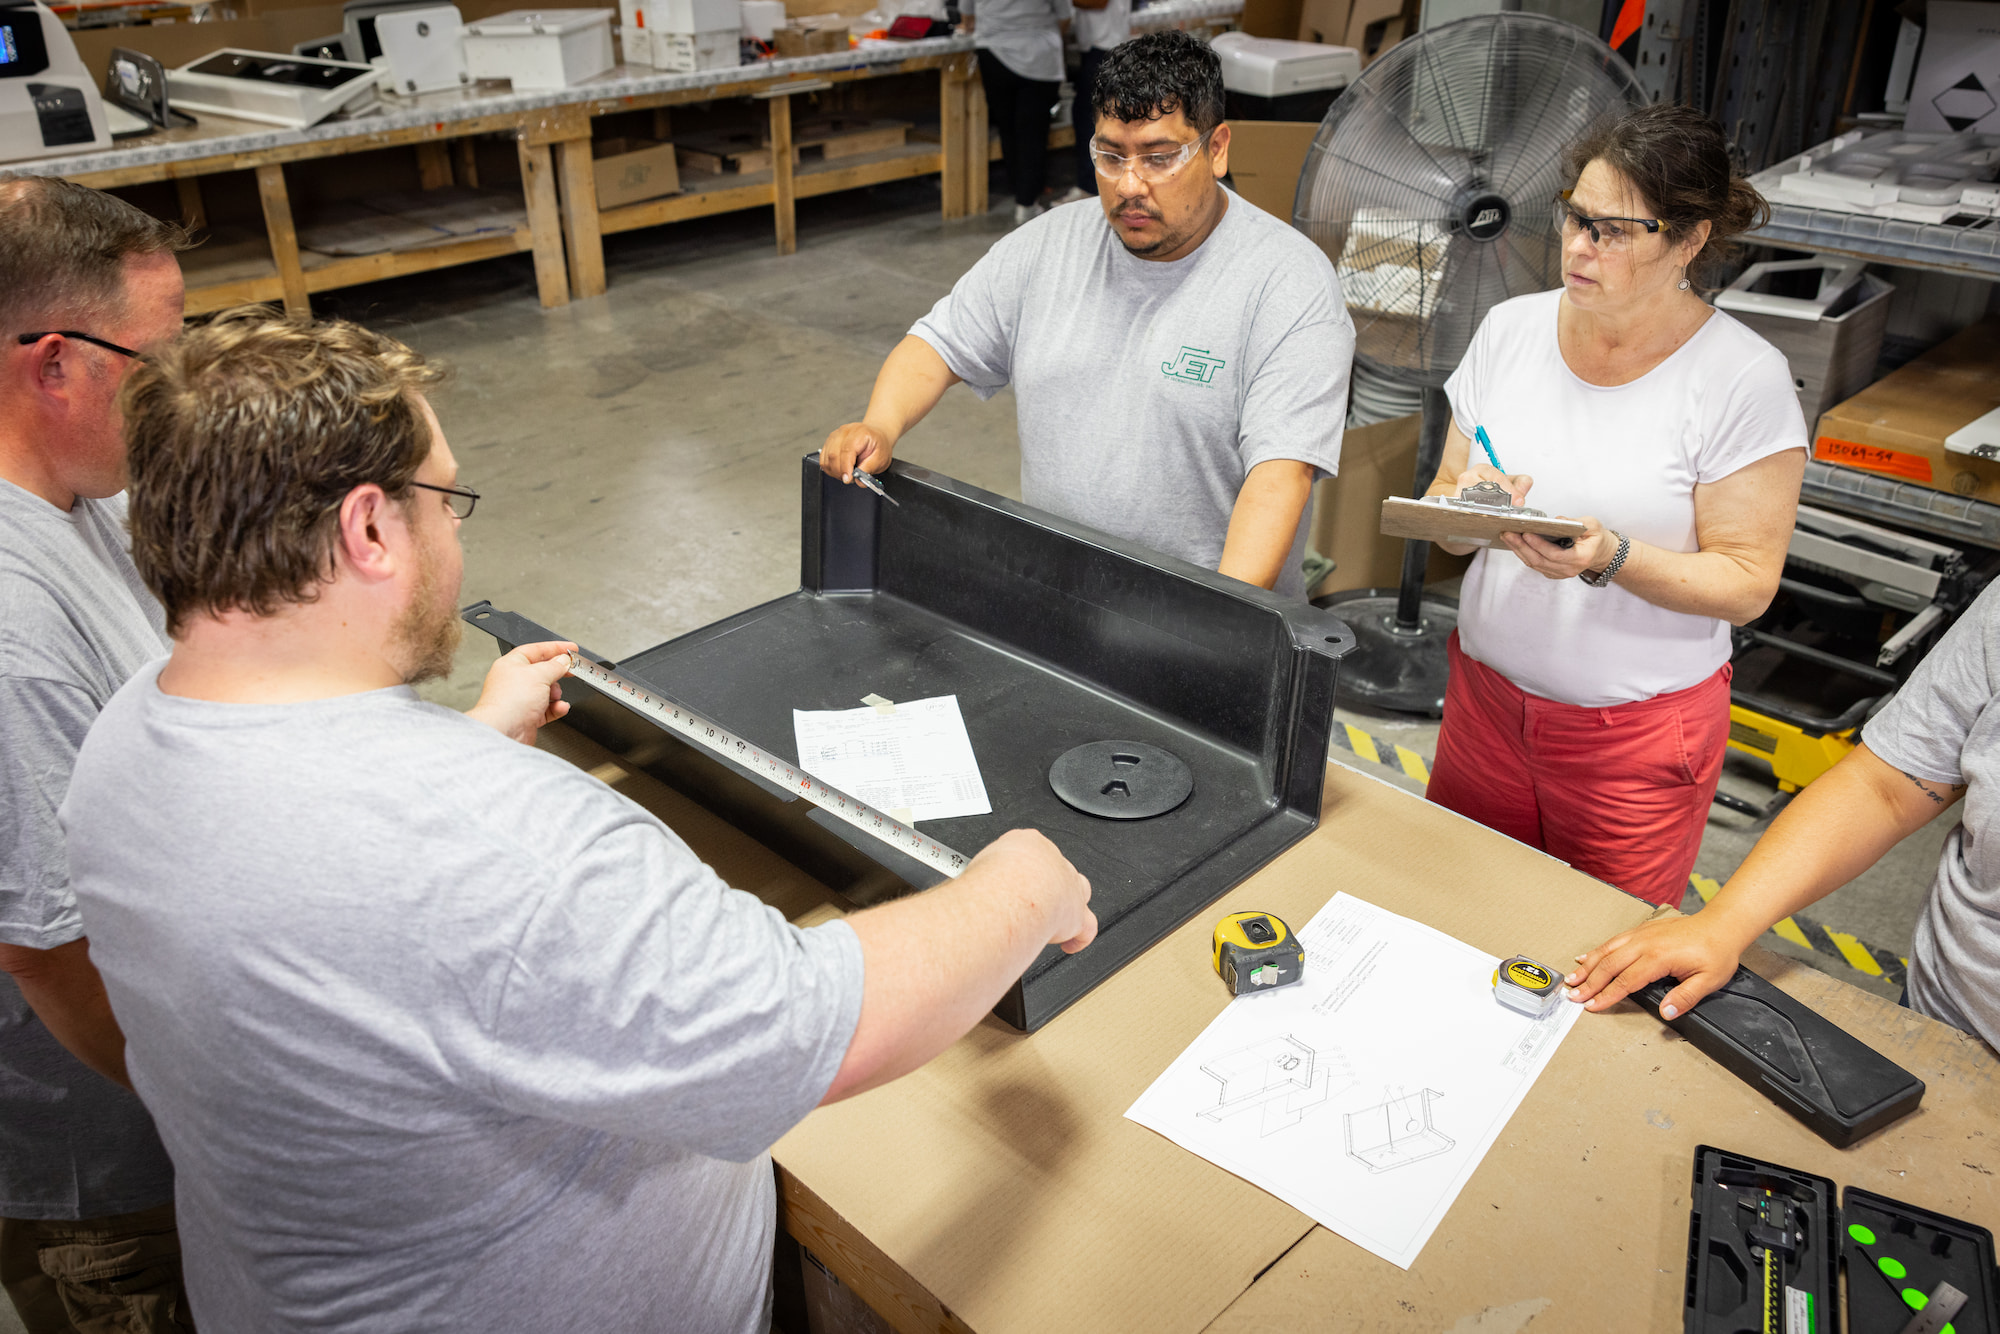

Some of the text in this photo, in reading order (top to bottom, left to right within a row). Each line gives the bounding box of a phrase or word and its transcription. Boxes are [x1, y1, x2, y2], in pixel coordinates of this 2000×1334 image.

[1161, 345, 1226, 383] JET
[589, 666, 594, 674] 2
[602, 673, 608, 681] 3
[616, 681, 621, 689] 4
[630, 687, 636, 696] 5
[644, 695, 650, 704] 6
[658, 703, 664, 711] 7
[673, 710, 679, 719] 8
[688, 718, 695, 727] 9
[705, 727, 715, 737] 10
[720, 735, 729, 745] 11
[769, 764, 776, 772] 14
[820, 790, 828, 798] 17
[838, 800, 846, 808] 18
[856, 808, 864, 817] 19
[873, 820, 882, 828] 20
[892, 829, 900, 838] 21
[911, 839, 920, 848] 22
[931, 850, 940, 858] 23
[951, 861, 960, 869] 24
